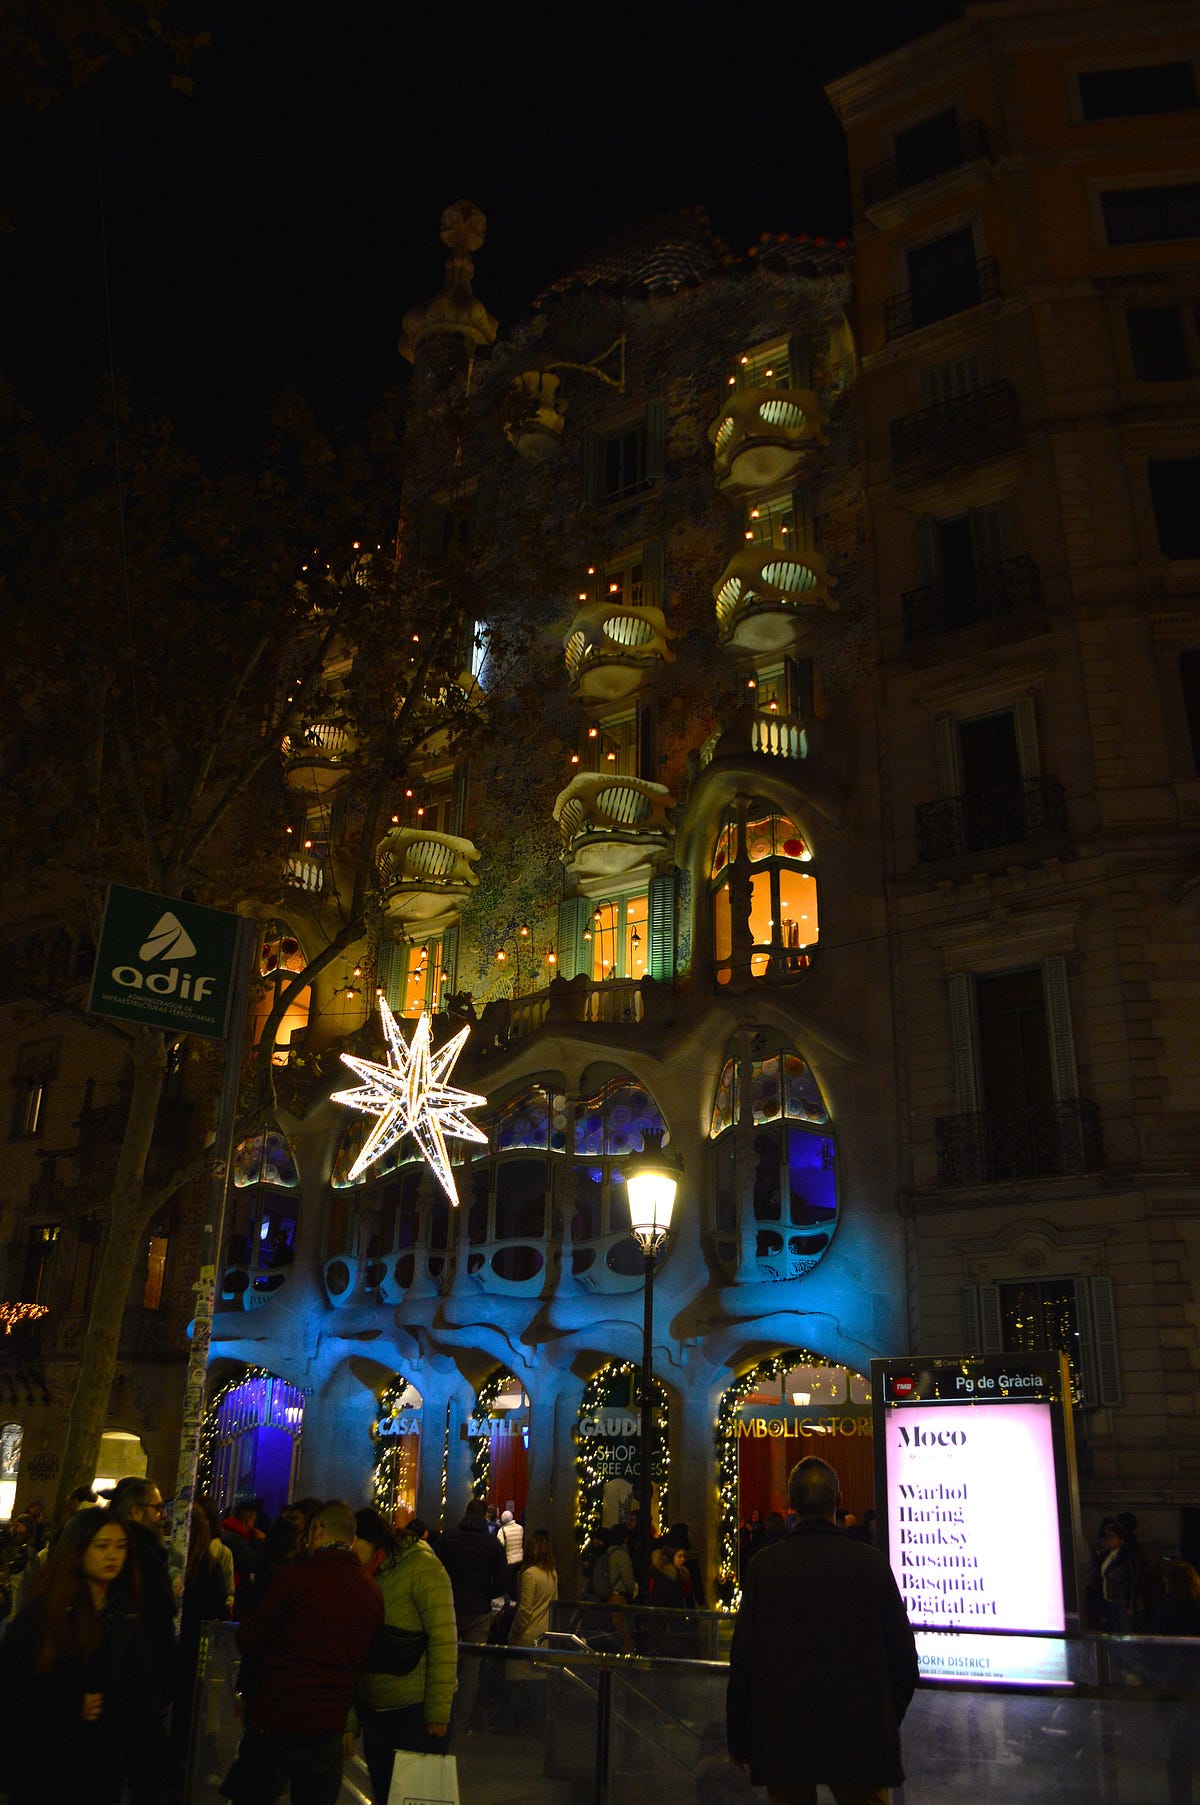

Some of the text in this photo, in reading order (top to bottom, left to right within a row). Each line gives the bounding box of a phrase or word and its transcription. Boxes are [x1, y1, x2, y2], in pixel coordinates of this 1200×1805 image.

[111, 966, 217, 1002] adif
[955, 1374, 1043, 1392] Pg de Gràcia
[378, 1418, 420, 1436] CASA
[898, 1426, 967, 1447] Moco
[596, 1445, 637, 1461] SHOP
[898, 1484, 967, 1500] Warhol
[899, 1505, 965, 1527] Haring
[900, 1528, 968, 1549] Banksy
[901, 1551, 978, 1568] Kusama
[902, 1573, 984, 1594] Basquiat
[947, 1656, 991, 1669] DISTRICT
